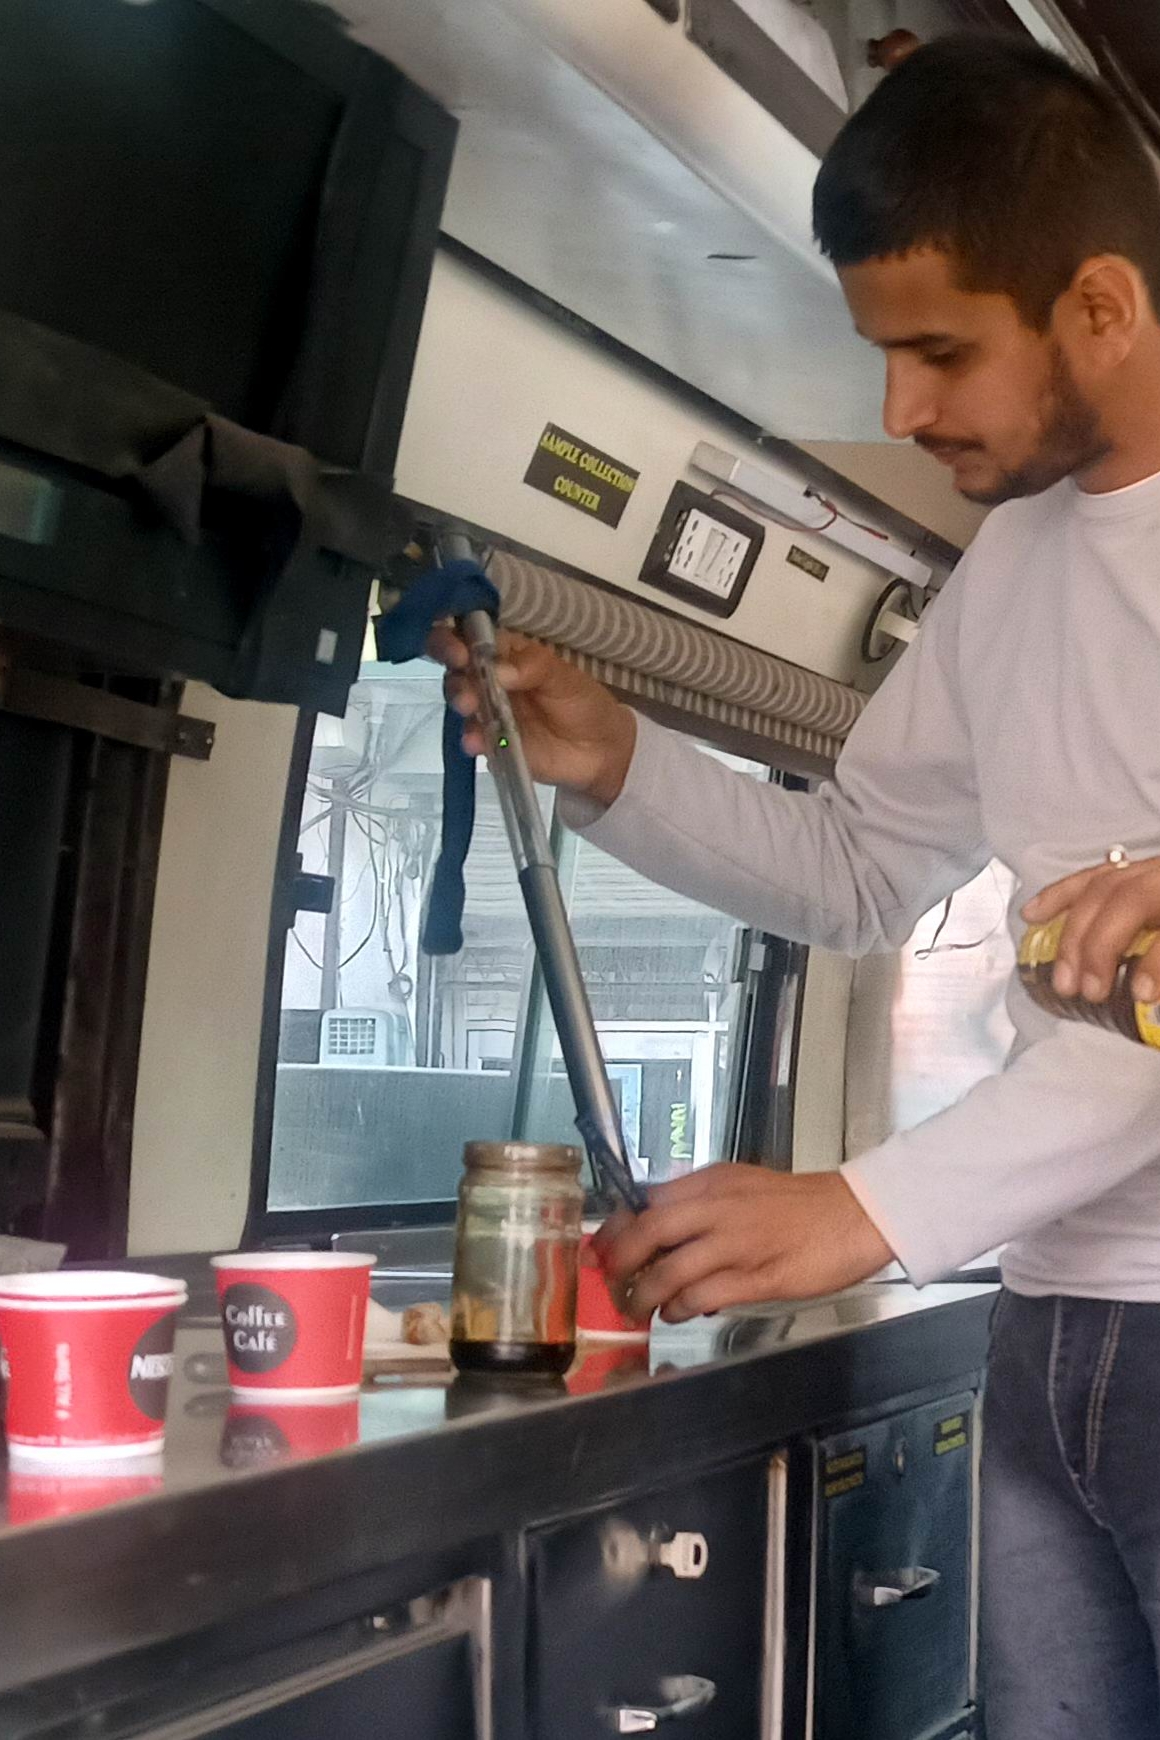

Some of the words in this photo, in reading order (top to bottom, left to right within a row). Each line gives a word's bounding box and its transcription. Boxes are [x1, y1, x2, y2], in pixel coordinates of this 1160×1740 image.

[540, 431, 581, 464] SAMPLE
[579, 452, 636, 493] COLLECTION
[553, 475, 601, 511] COUNTER
